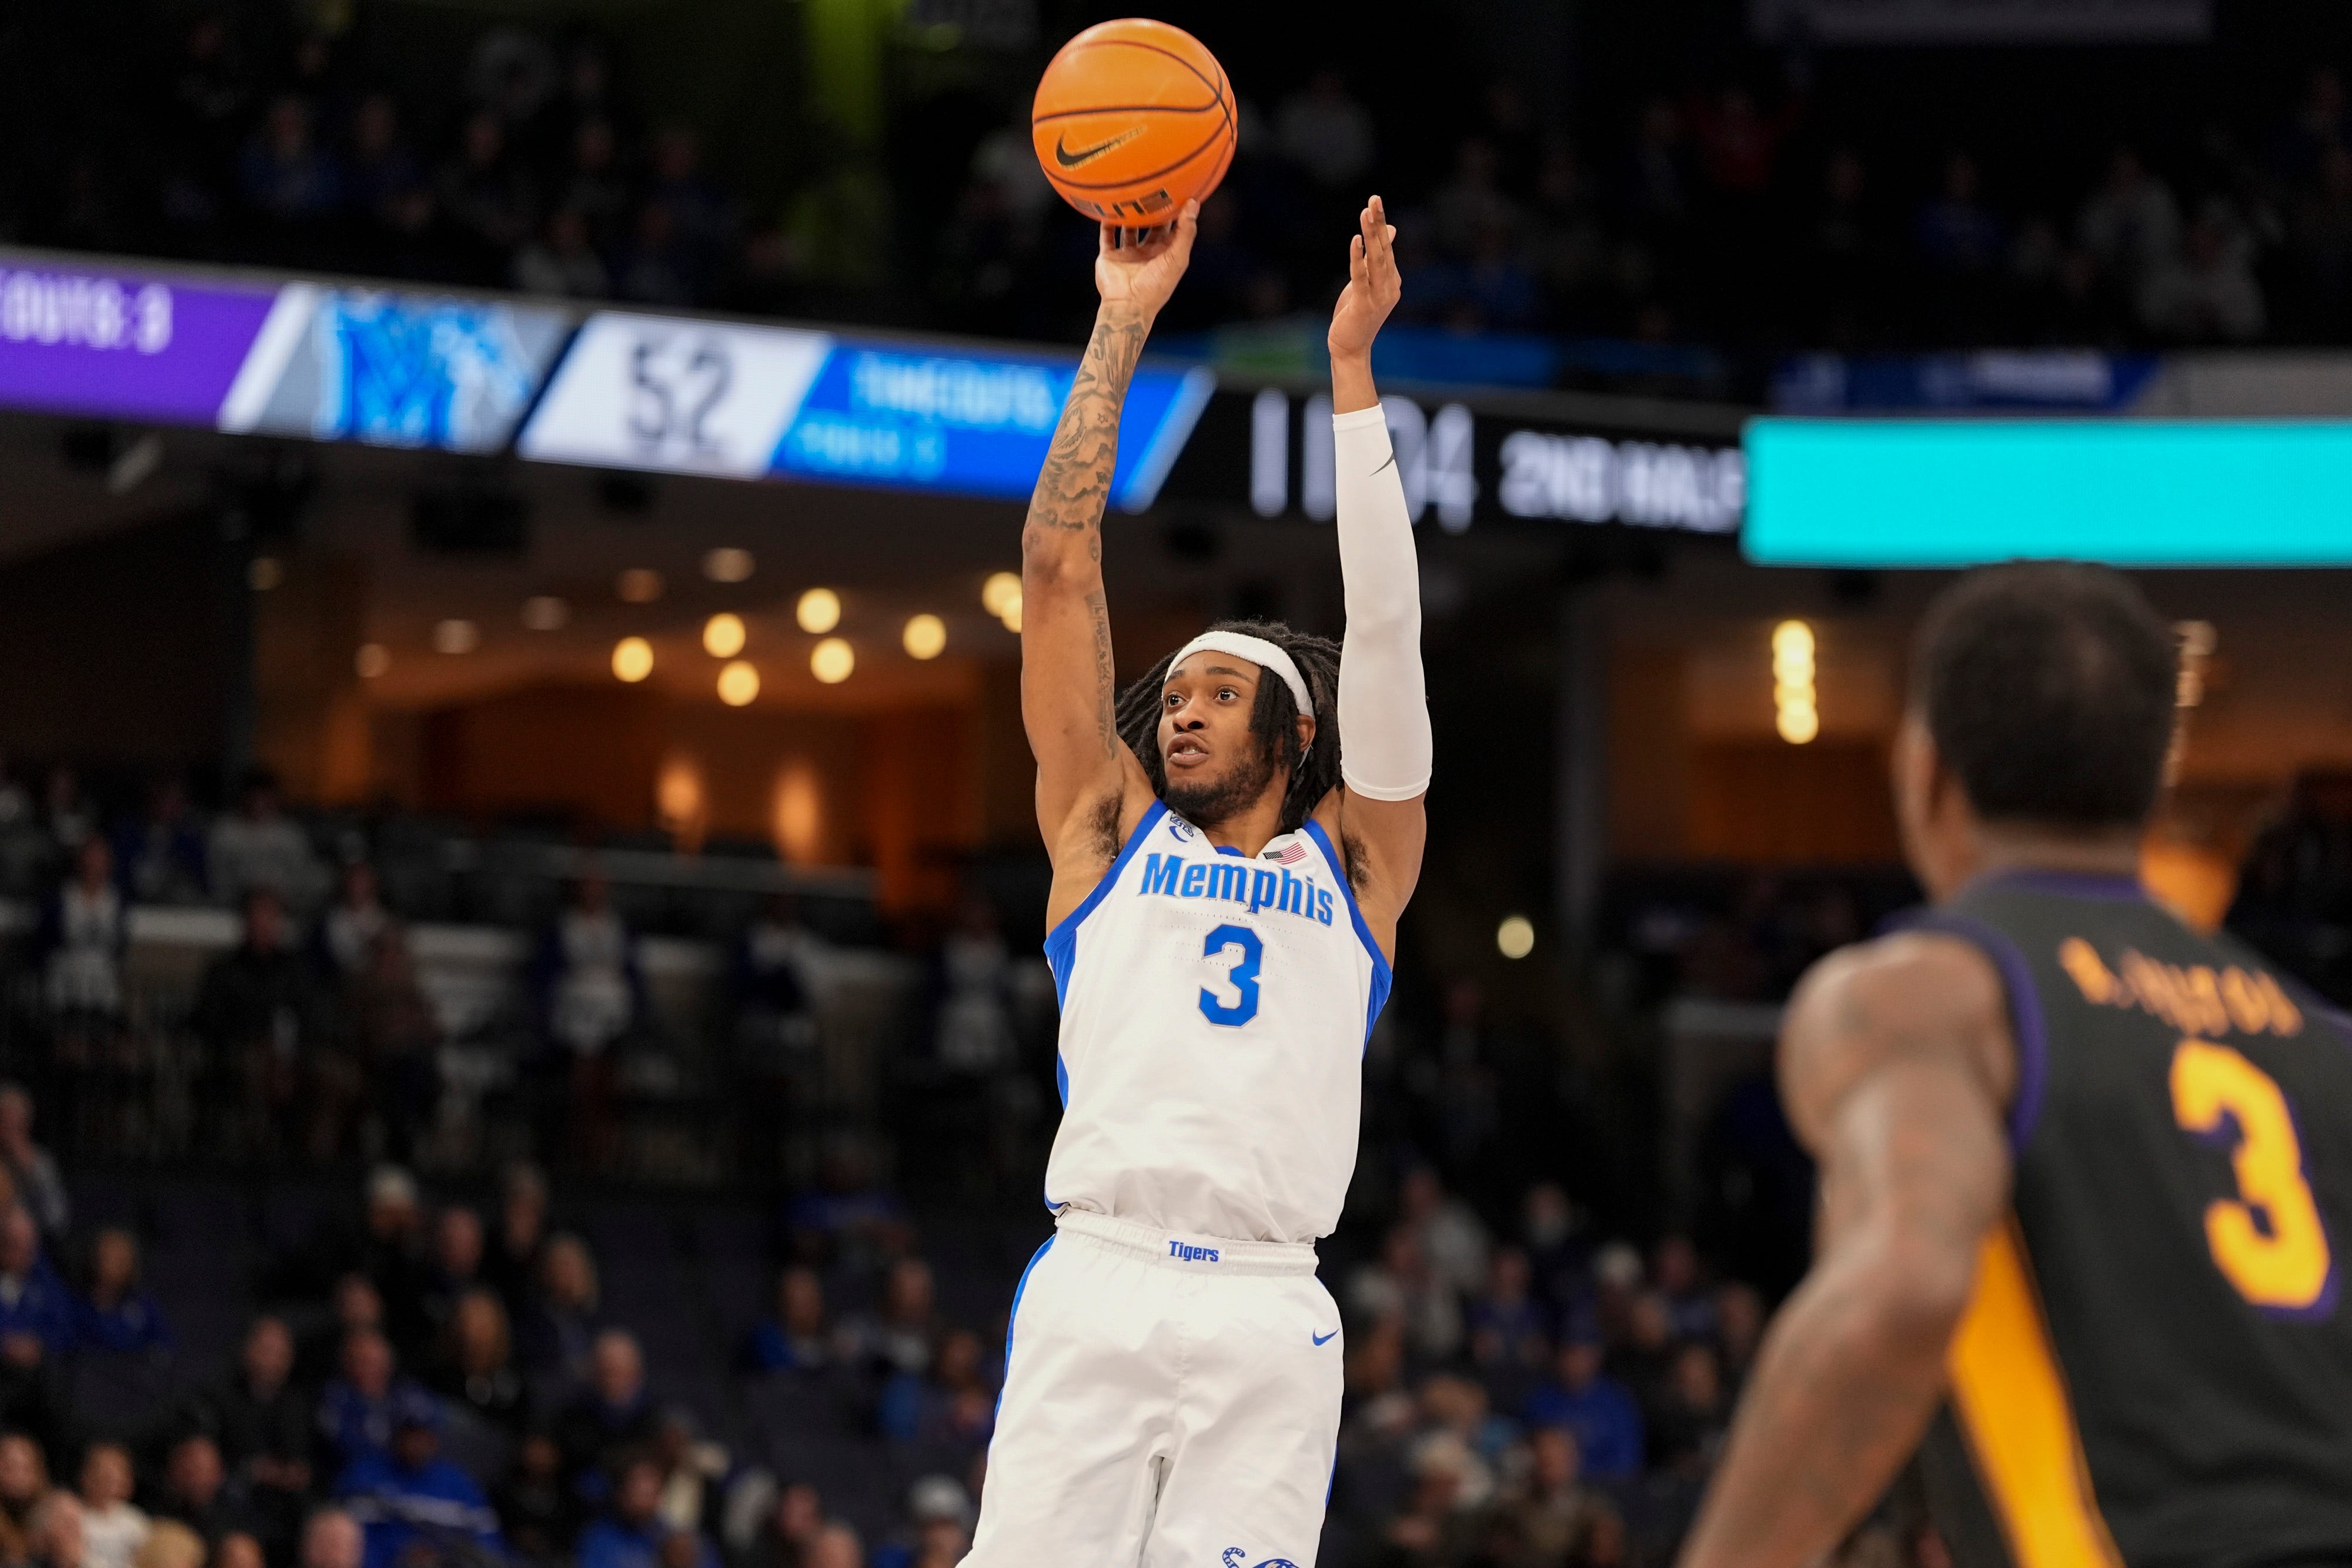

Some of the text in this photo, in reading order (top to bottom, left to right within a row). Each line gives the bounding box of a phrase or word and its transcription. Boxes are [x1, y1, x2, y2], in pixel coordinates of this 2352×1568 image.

[627, 342, 735, 452] 52
[1137, 852, 1334, 928] Memphis
[1197, 924, 1264, 1029] 3
[2169, 1037, 2332, 1312] 3
[1168, 1241, 1219, 1262] Tigers
